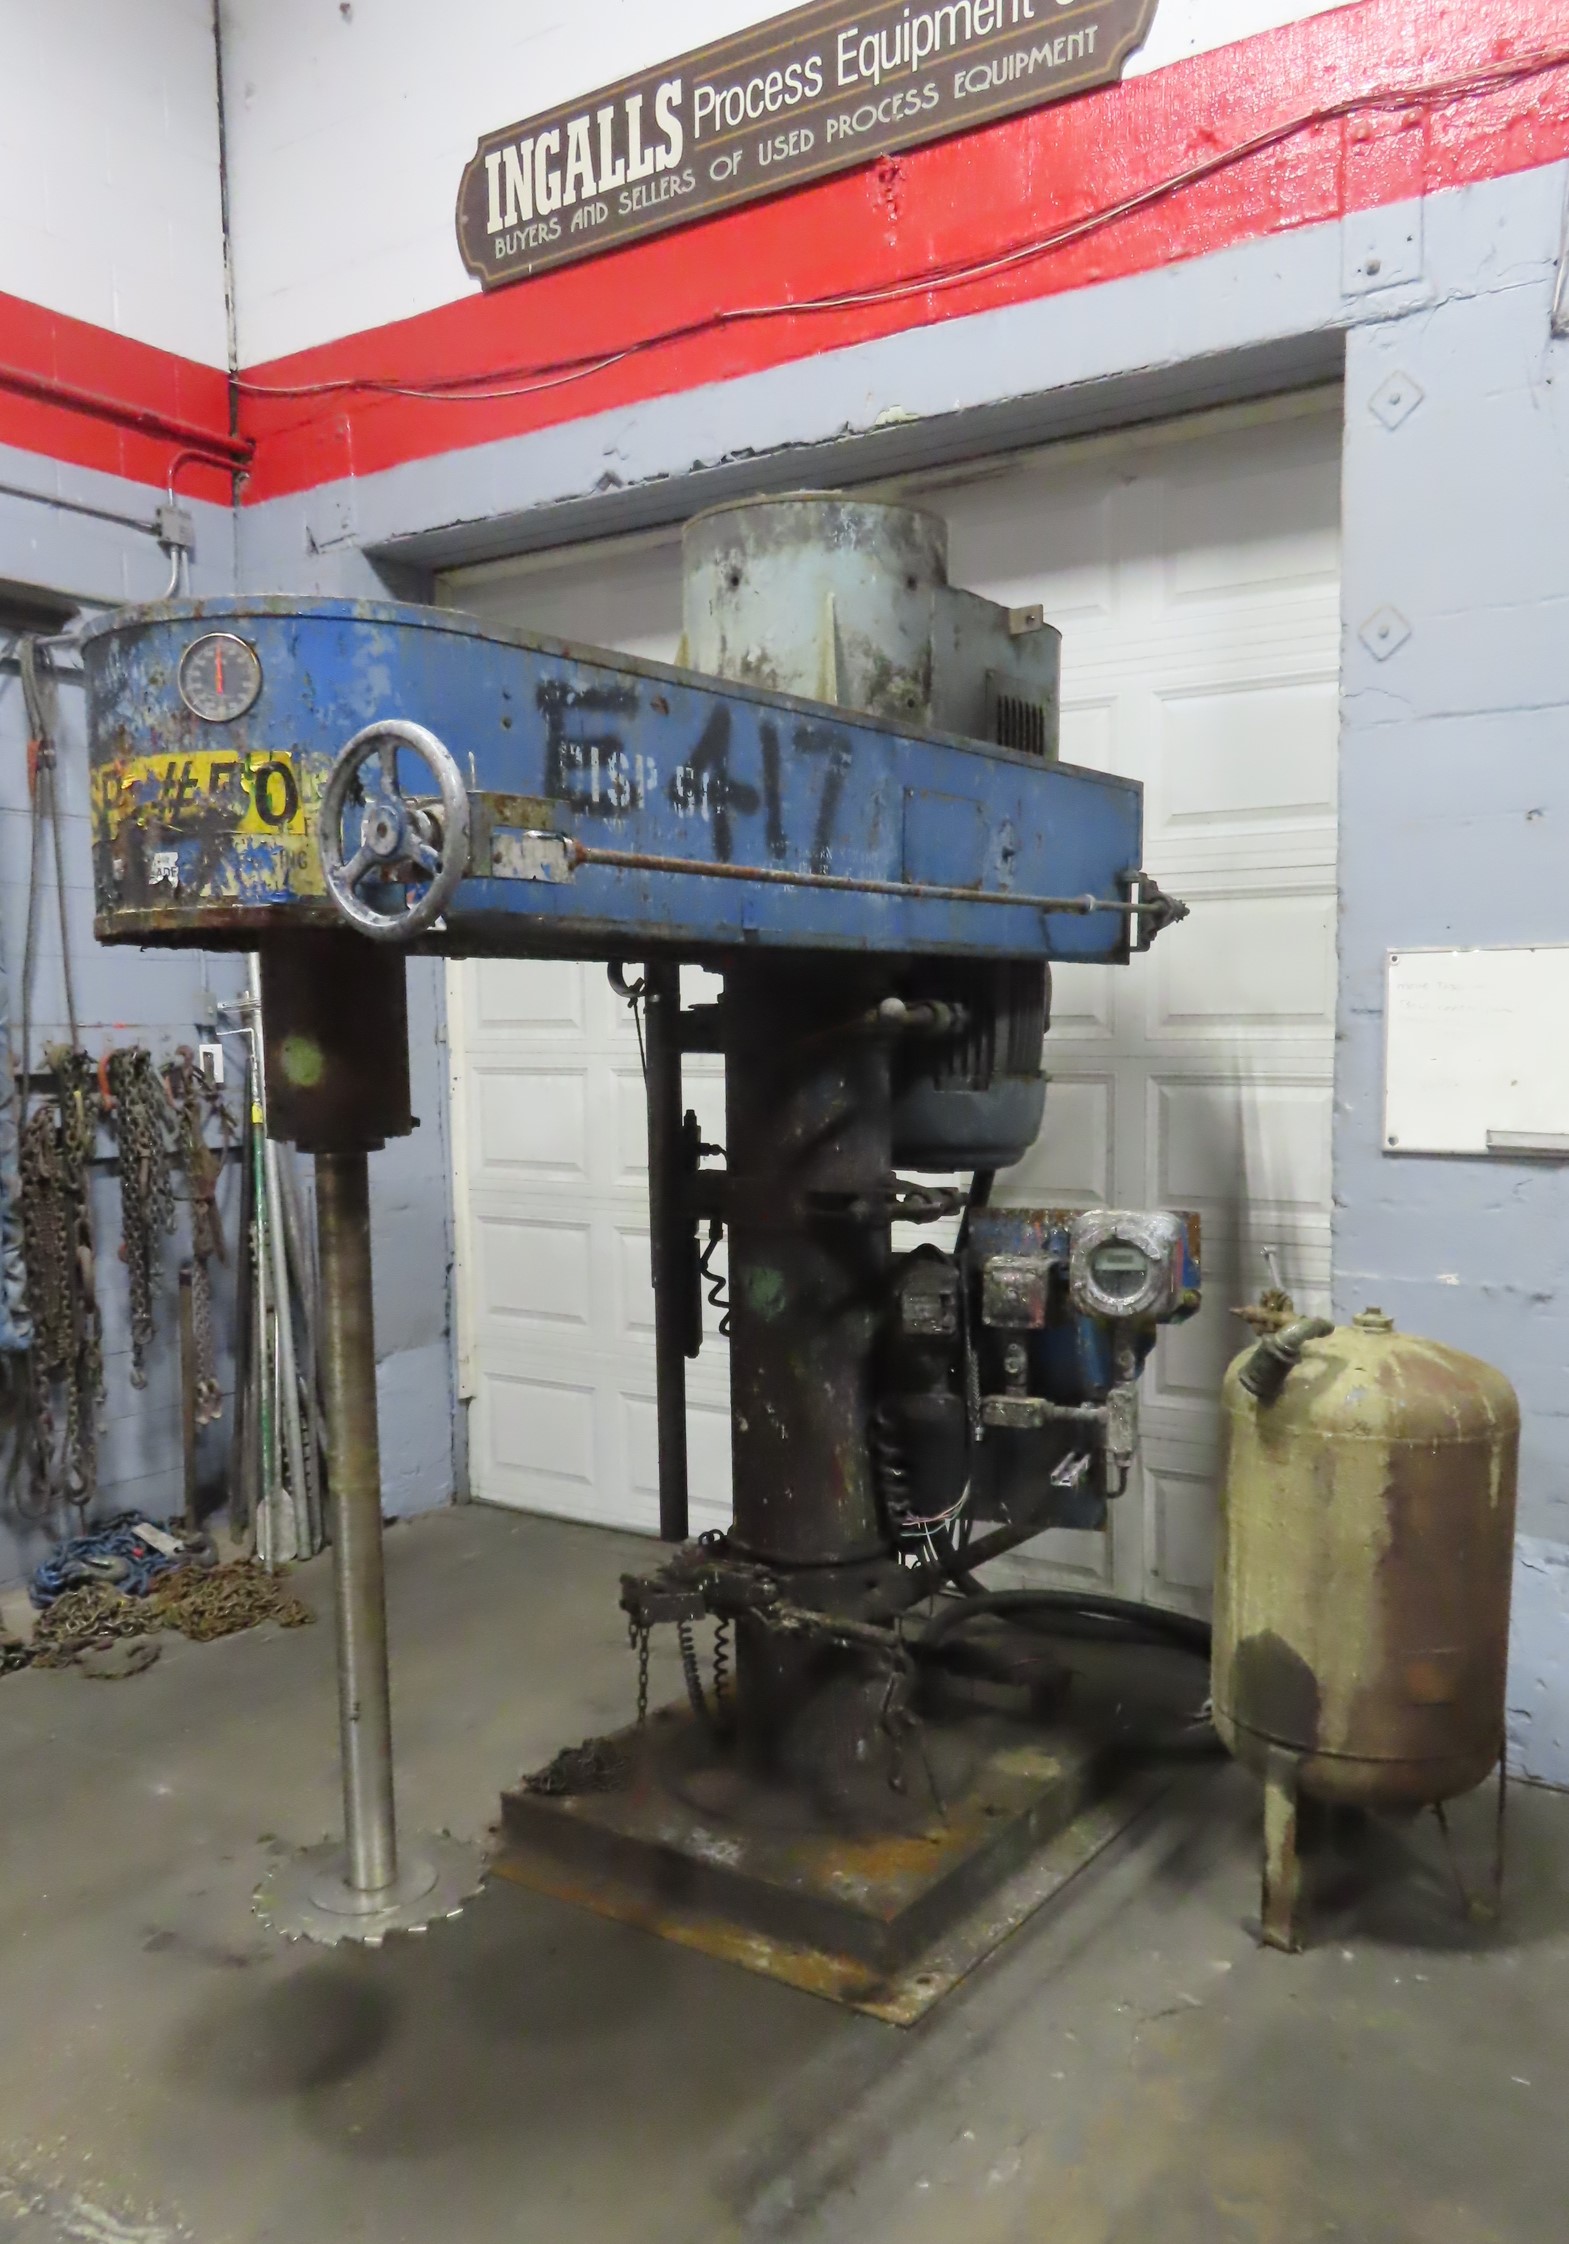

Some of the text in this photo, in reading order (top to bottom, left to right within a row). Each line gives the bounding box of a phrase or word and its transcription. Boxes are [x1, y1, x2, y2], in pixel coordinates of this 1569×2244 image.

[485, 79, 684, 235] INGALLS
[694, 56, 823, 138] Process
[495, 25, 1098, 259] BUYERS AND SELLERS OF USED PROCESS EQUIPMENT
